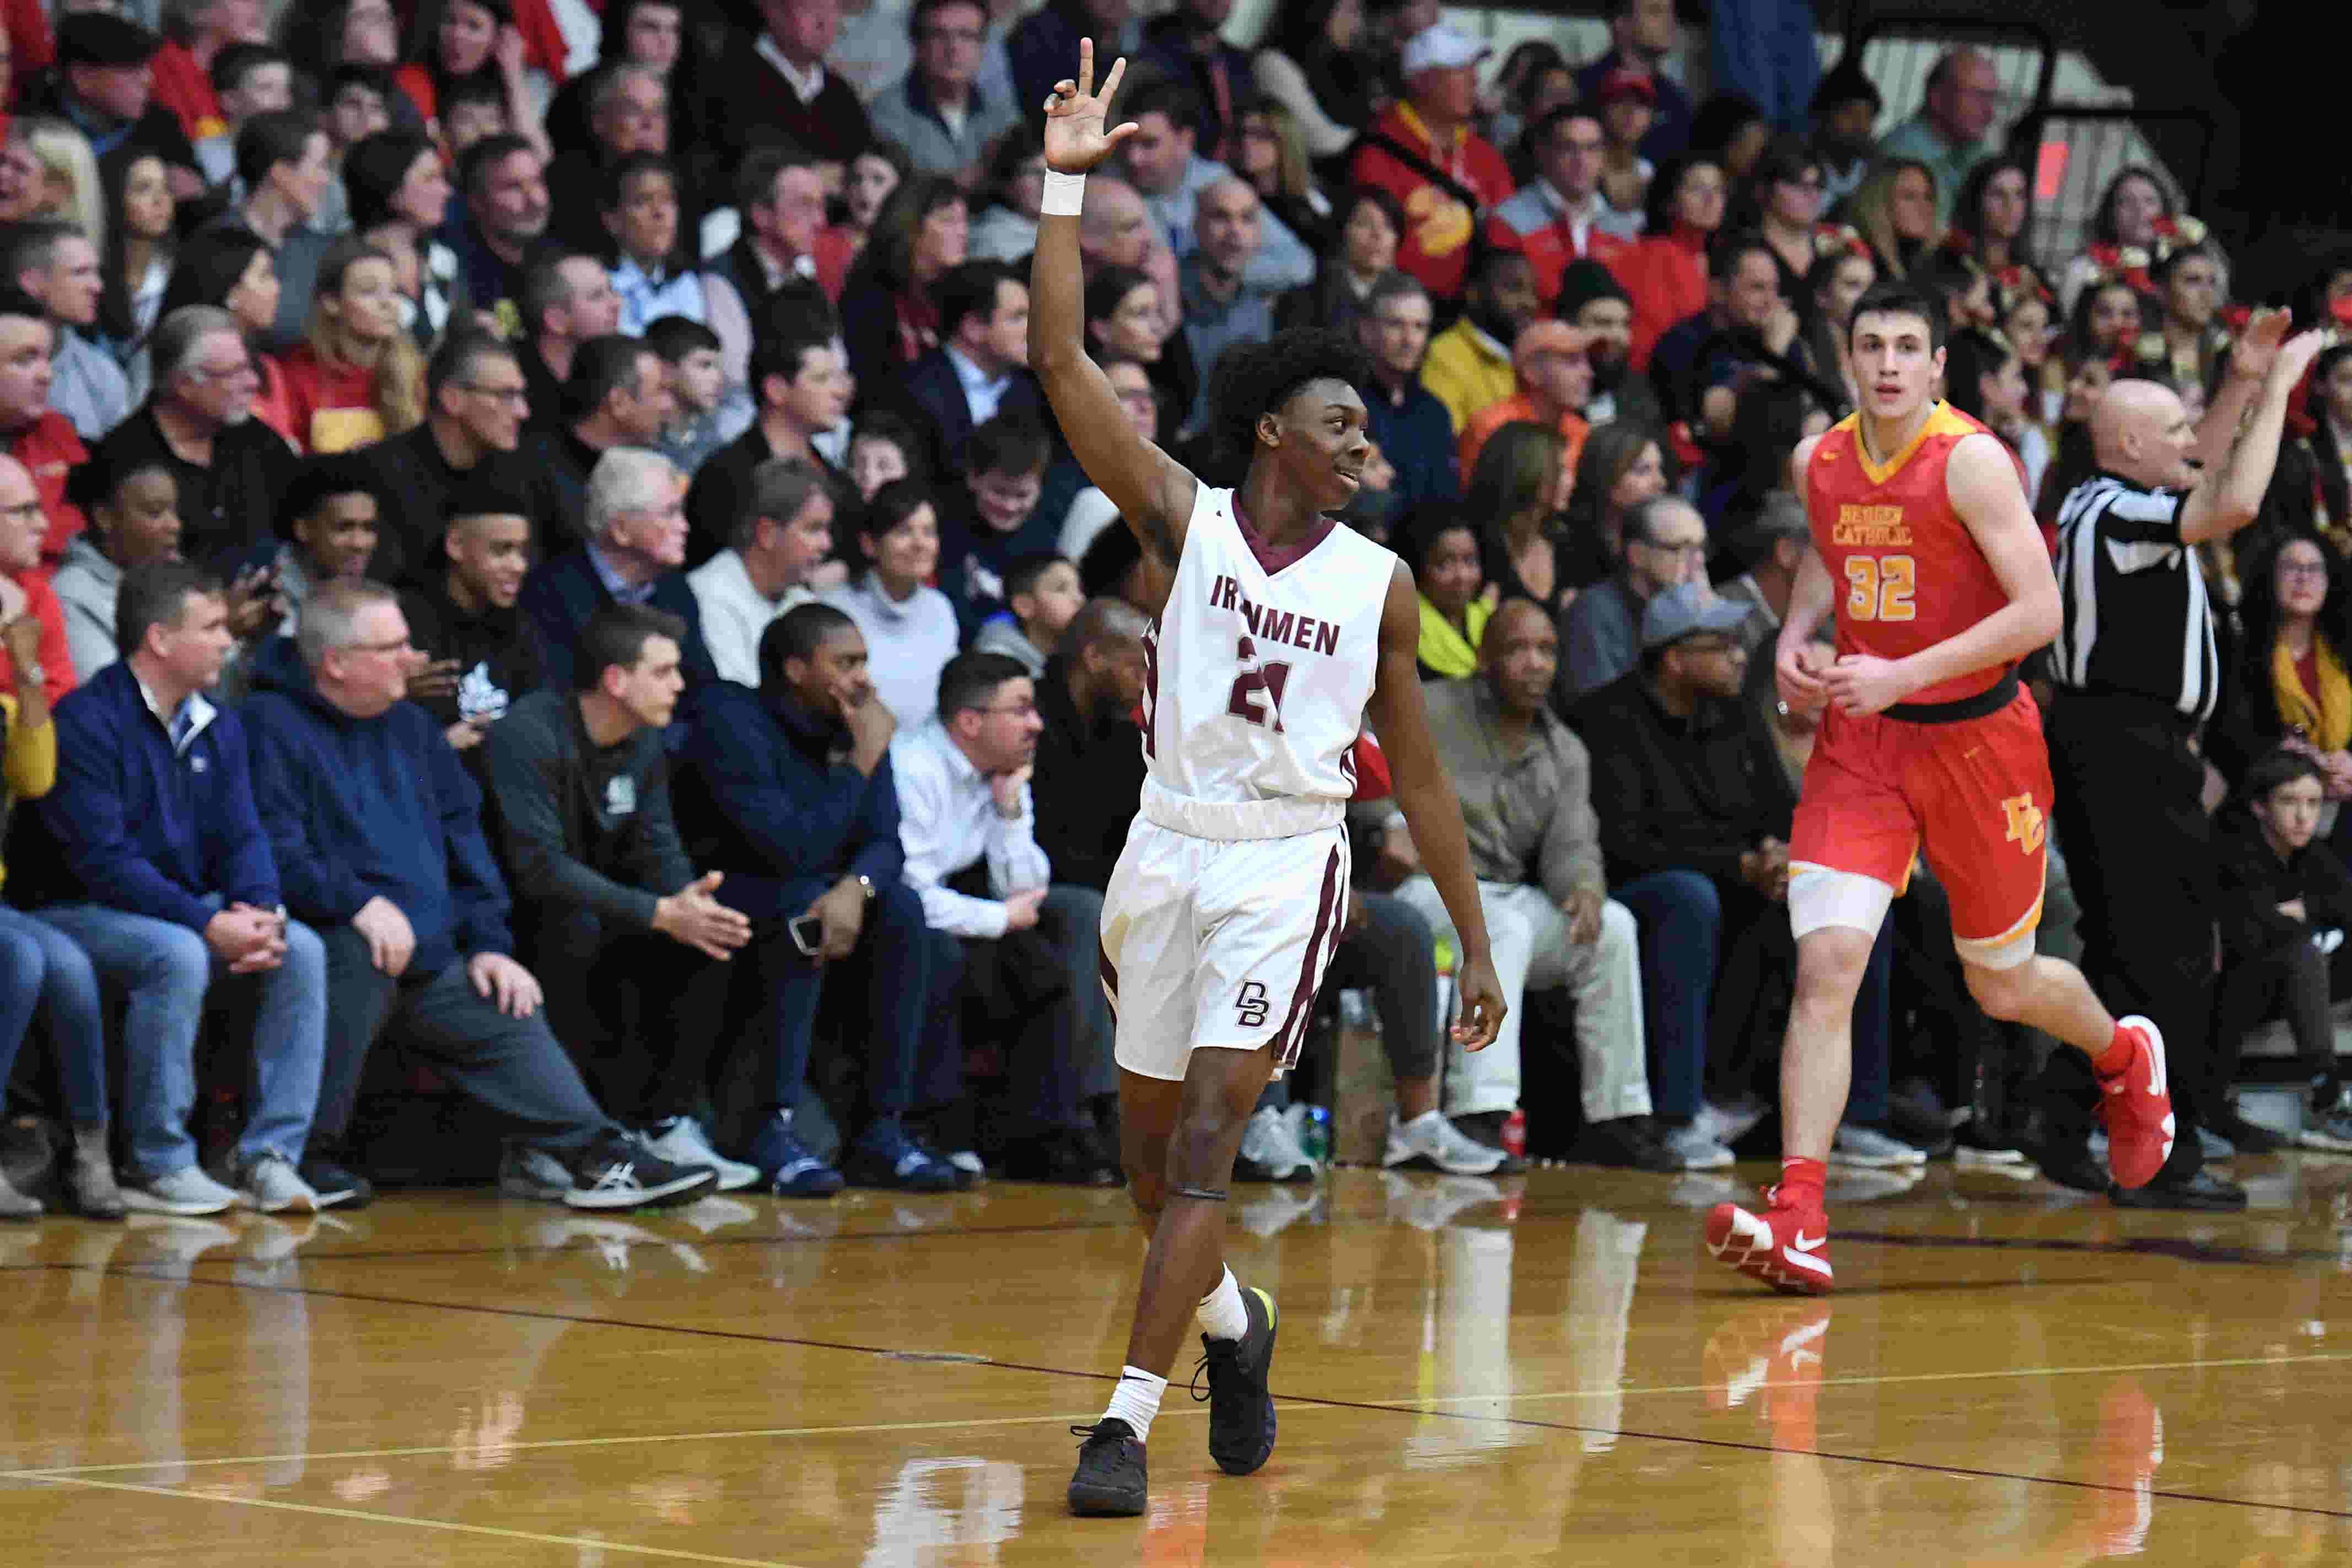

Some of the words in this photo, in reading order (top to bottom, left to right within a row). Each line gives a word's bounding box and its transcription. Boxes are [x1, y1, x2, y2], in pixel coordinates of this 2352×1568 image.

[1209, 574, 1341, 656] IRNMEN
[1844, 555, 1916, 622] 32
[1225, 634, 1293, 735] 21
